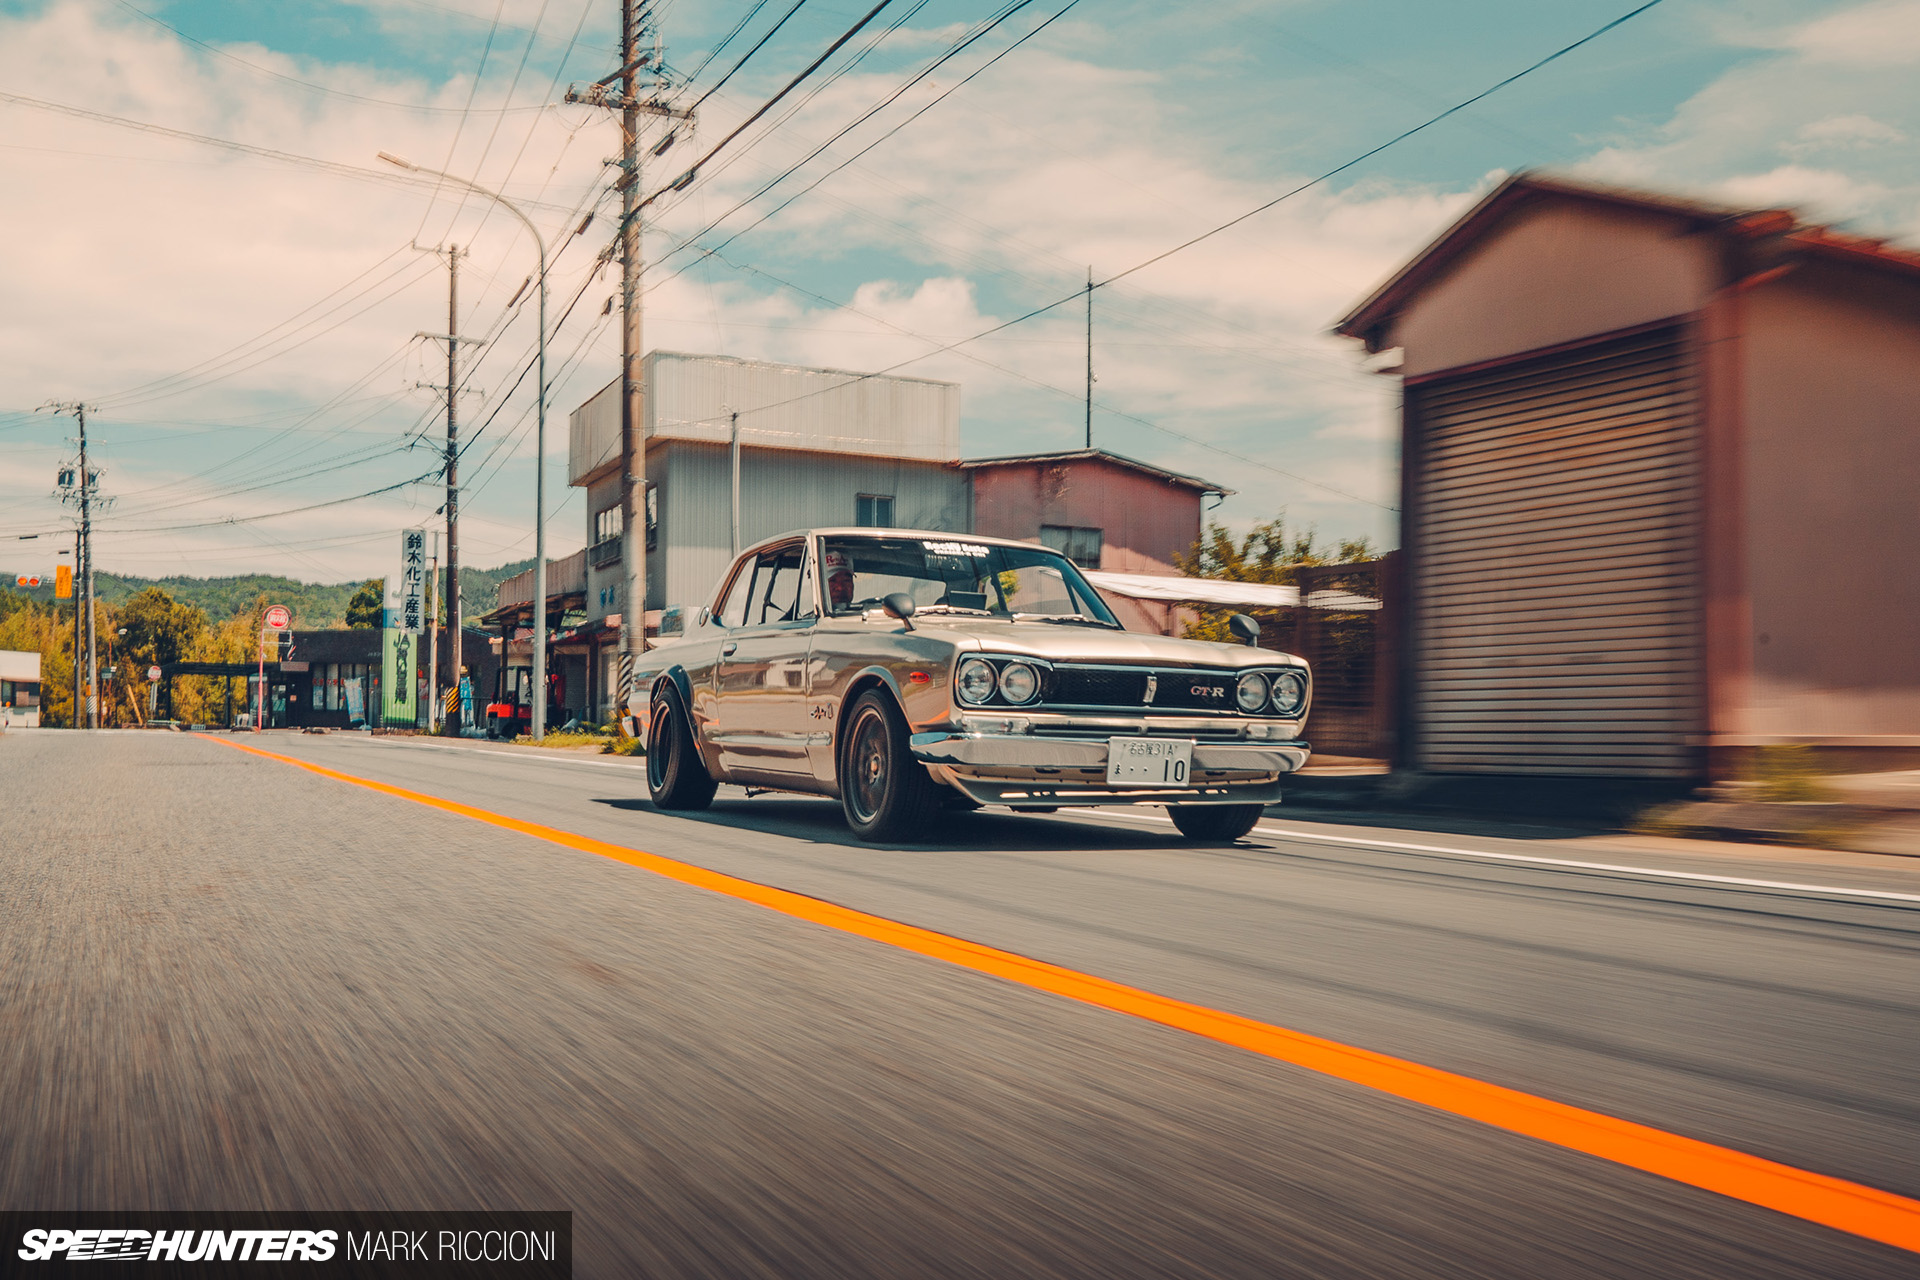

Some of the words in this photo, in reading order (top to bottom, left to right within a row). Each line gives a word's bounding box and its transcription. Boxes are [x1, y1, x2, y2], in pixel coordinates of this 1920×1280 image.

[405, 533, 422, 630] 鈴木化工産業
[1190, 685, 1225, 698] GT-R
